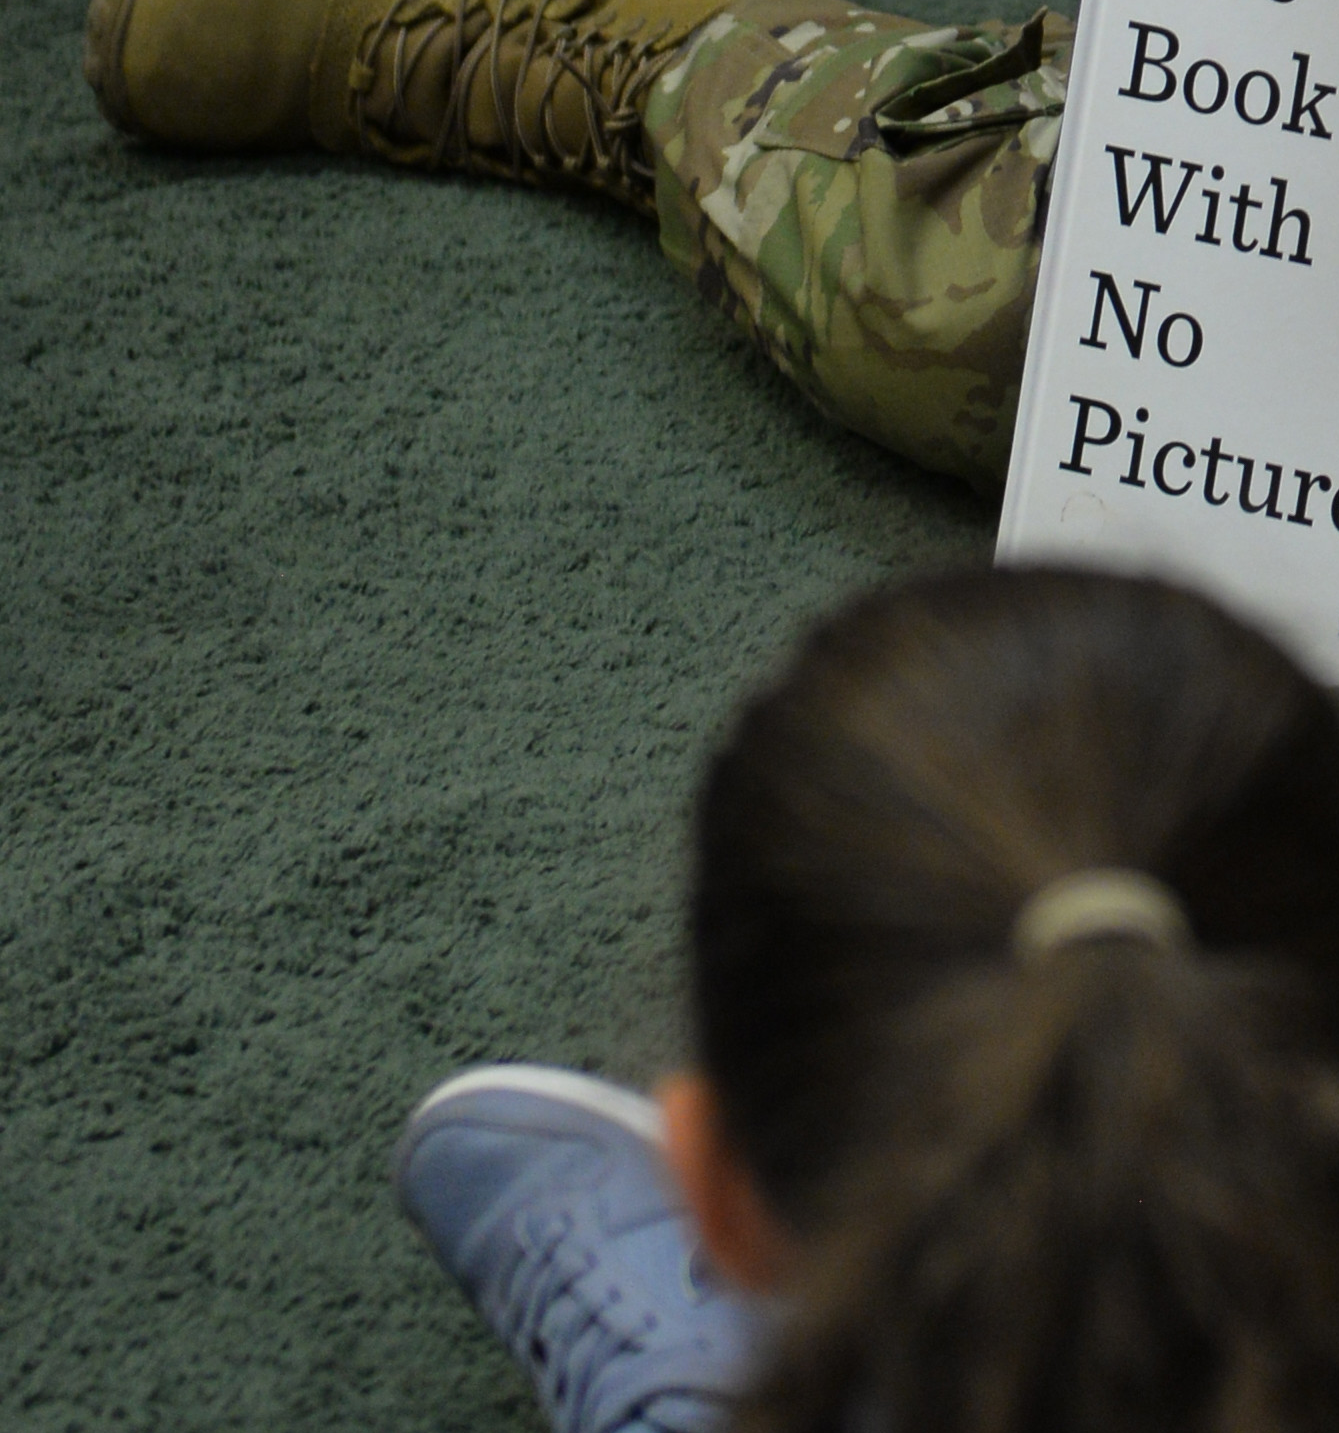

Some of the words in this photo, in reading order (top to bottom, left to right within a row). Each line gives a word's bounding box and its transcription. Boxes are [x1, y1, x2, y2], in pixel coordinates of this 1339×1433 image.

[1117, 20, 1338, 141] Book
[1104, 144, 1313, 267] With
[1078, 270, 1204, 368] No
